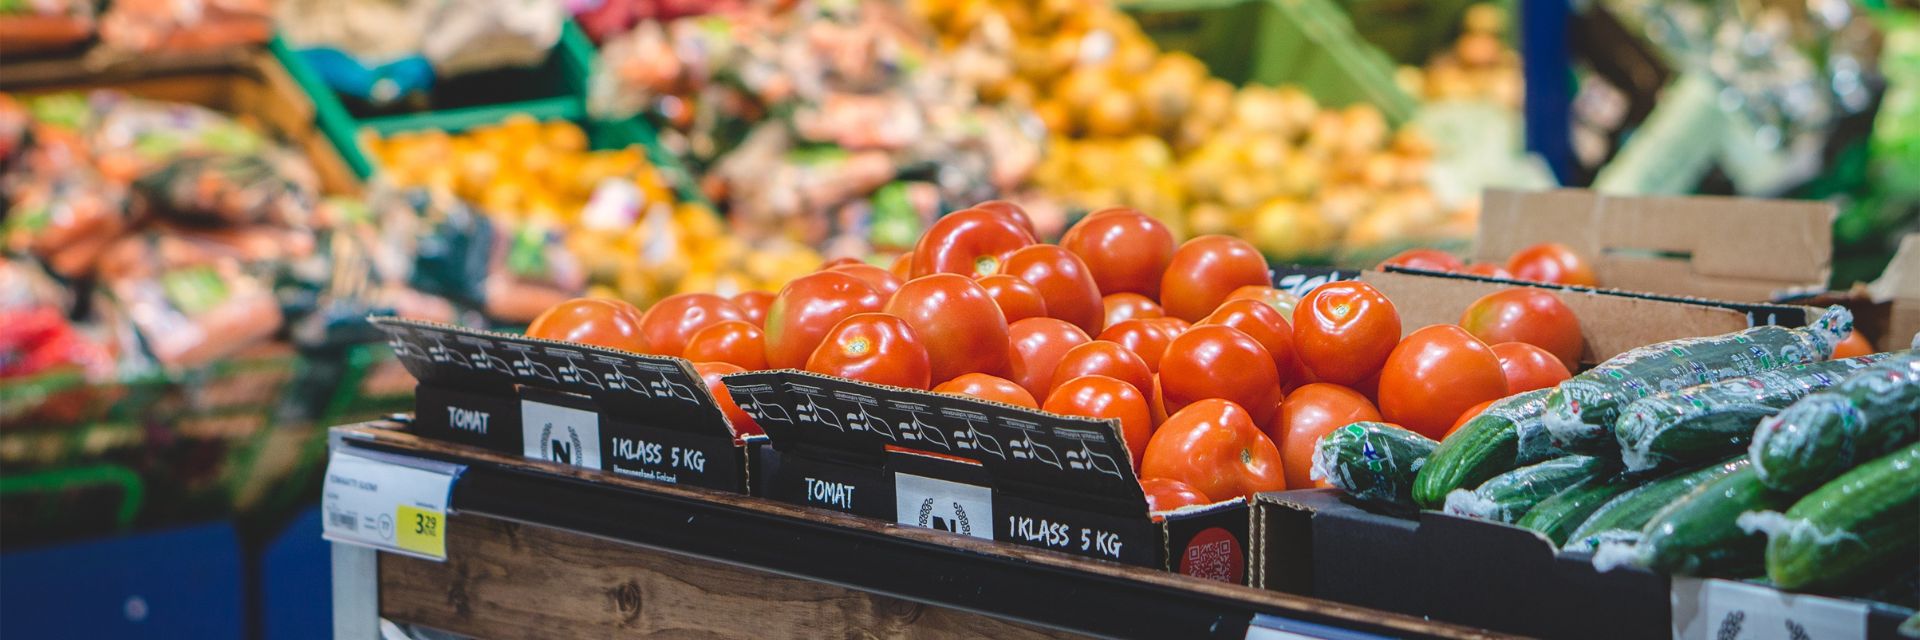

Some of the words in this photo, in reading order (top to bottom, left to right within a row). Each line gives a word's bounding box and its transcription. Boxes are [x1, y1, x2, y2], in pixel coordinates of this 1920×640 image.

[447, 406, 490, 434] TOMAT
[552, 439, 571, 464] N
[620, 438, 662, 464] KLASS
[671, 446, 680, 468] 5
[683, 448, 706, 473] KG
[804, 477, 856, 509] TOMAT
[1018, 516, 1070, 547] KLASS
[1081, 528, 1091, 551] 5
[1096, 530, 1122, 558] KG
